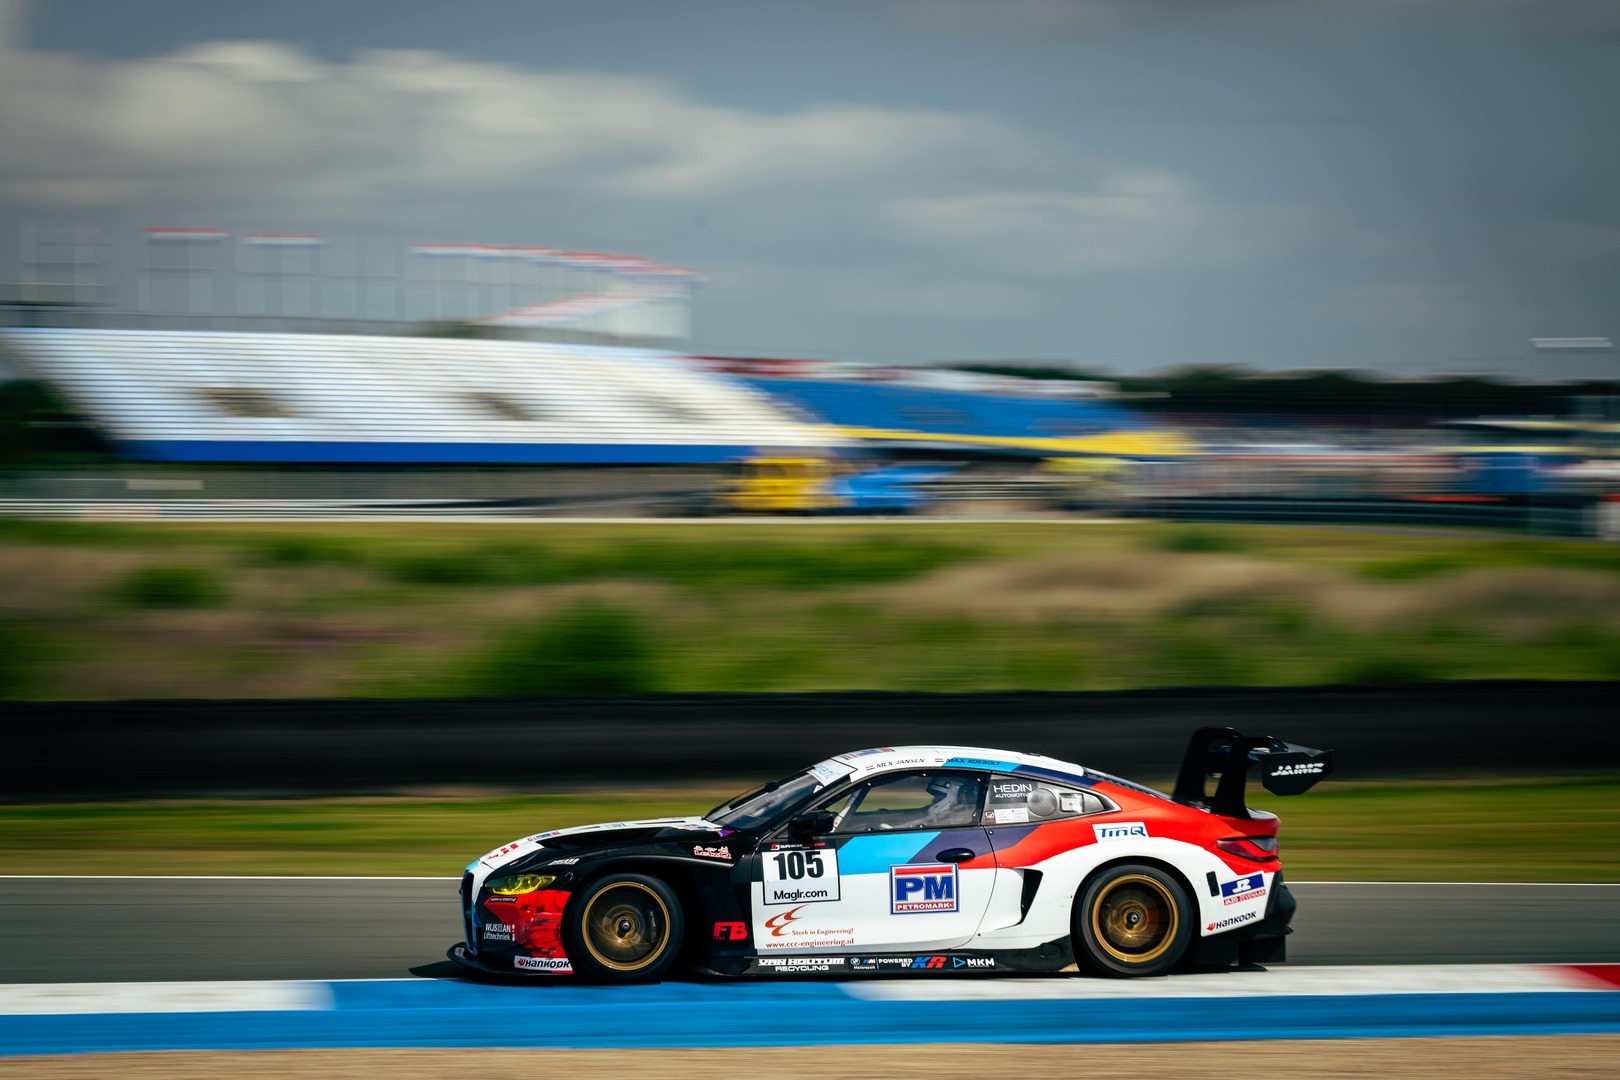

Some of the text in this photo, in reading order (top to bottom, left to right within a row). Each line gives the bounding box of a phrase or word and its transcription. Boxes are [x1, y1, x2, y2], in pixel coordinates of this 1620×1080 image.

[993, 783, 1033, 793] HEDIN
[773, 850, 825, 881] 105
[895, 874, 954, 902] PM
[773, 888, 828, 902] Maglr.com
[897, 902, 950, 911] PETROMARK
[766, 938, 854, 948] www.ccc-engineering.nl
[758, 958, 787, 966] VAN
[967, 957, 995, 967] MKM
